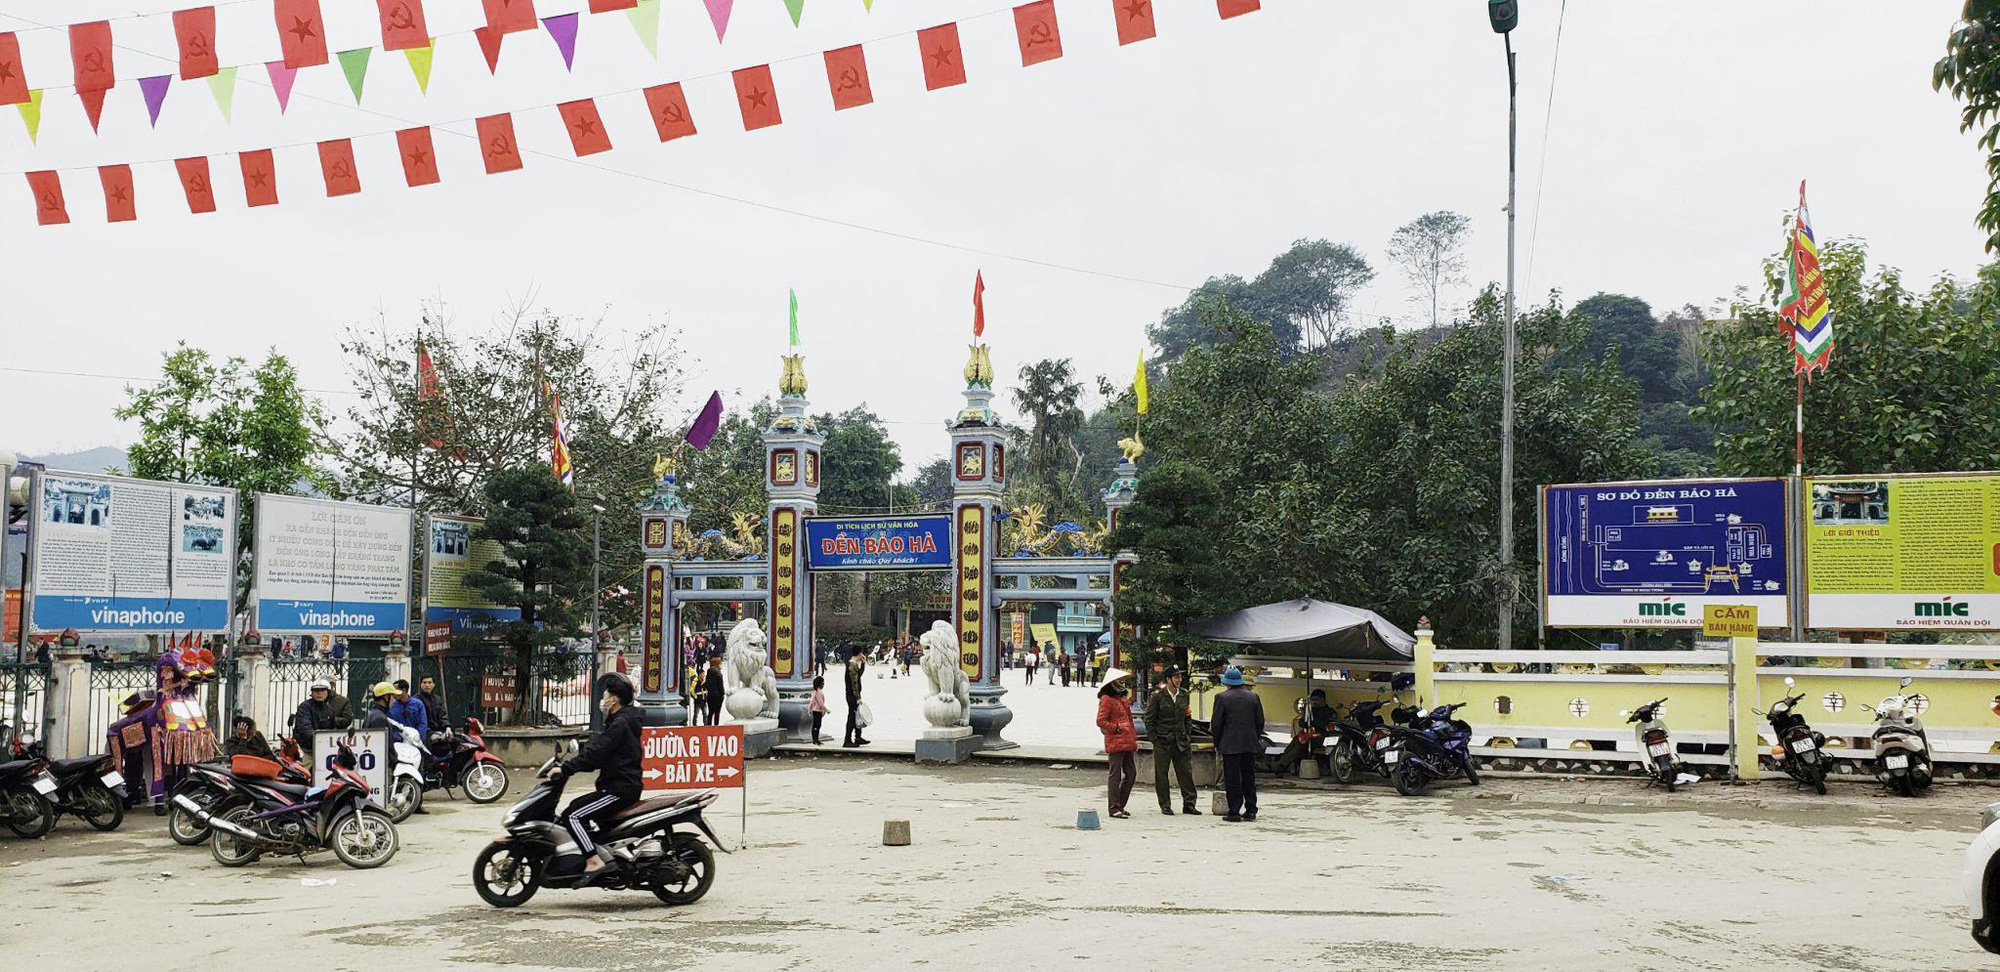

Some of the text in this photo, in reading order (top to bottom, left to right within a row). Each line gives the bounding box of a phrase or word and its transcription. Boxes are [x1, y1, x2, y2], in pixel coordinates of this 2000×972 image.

[1597, 492, 1616, 500] SƠ
[1680, 487, 1711, 498] BẢO
[1714, 487, 1737, 498] HÀ
[822, 531, 937, 555] ĐỀN BẢO HÀ
[91, 606, 185, 627] vinaphone
[299, 609, 375, 628] vinaphone
[665, 760, 715, 783] BÃI XE
